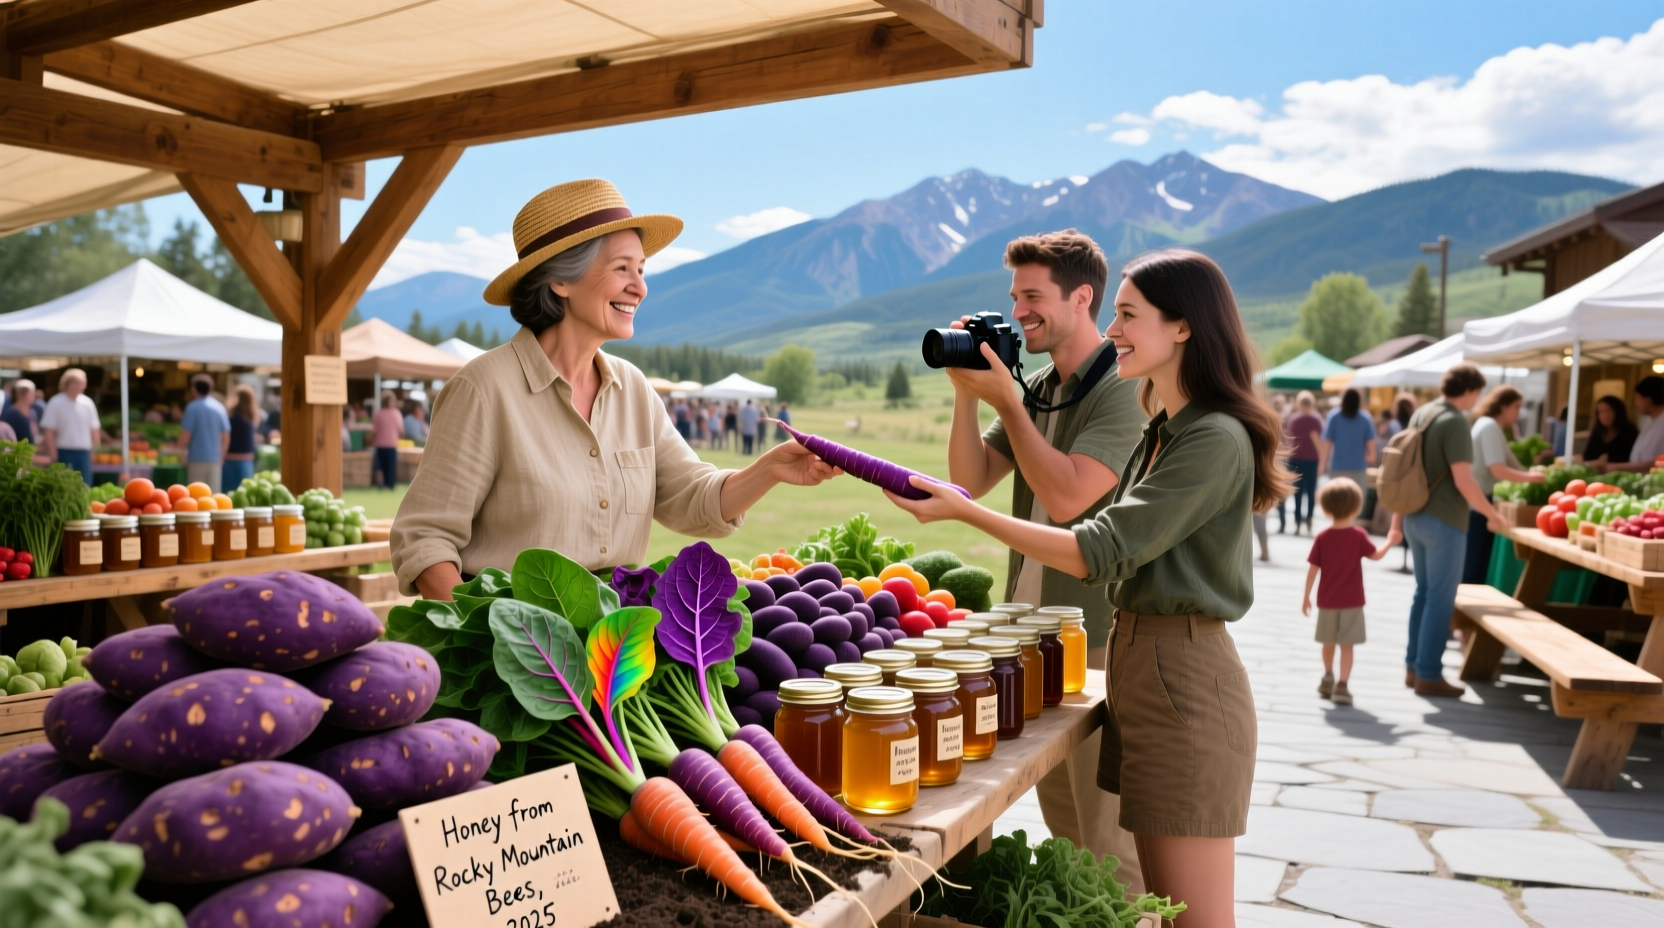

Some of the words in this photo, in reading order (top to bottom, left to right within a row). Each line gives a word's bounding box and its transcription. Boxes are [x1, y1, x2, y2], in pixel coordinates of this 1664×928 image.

[441, 814, 501, 848] Honey
[508, 798, 554, 832] from
[434, 856, 493, 896] Rocky
[501, 828, 584, 872] Mountain
[485, 881, 543, 915] Bees,
